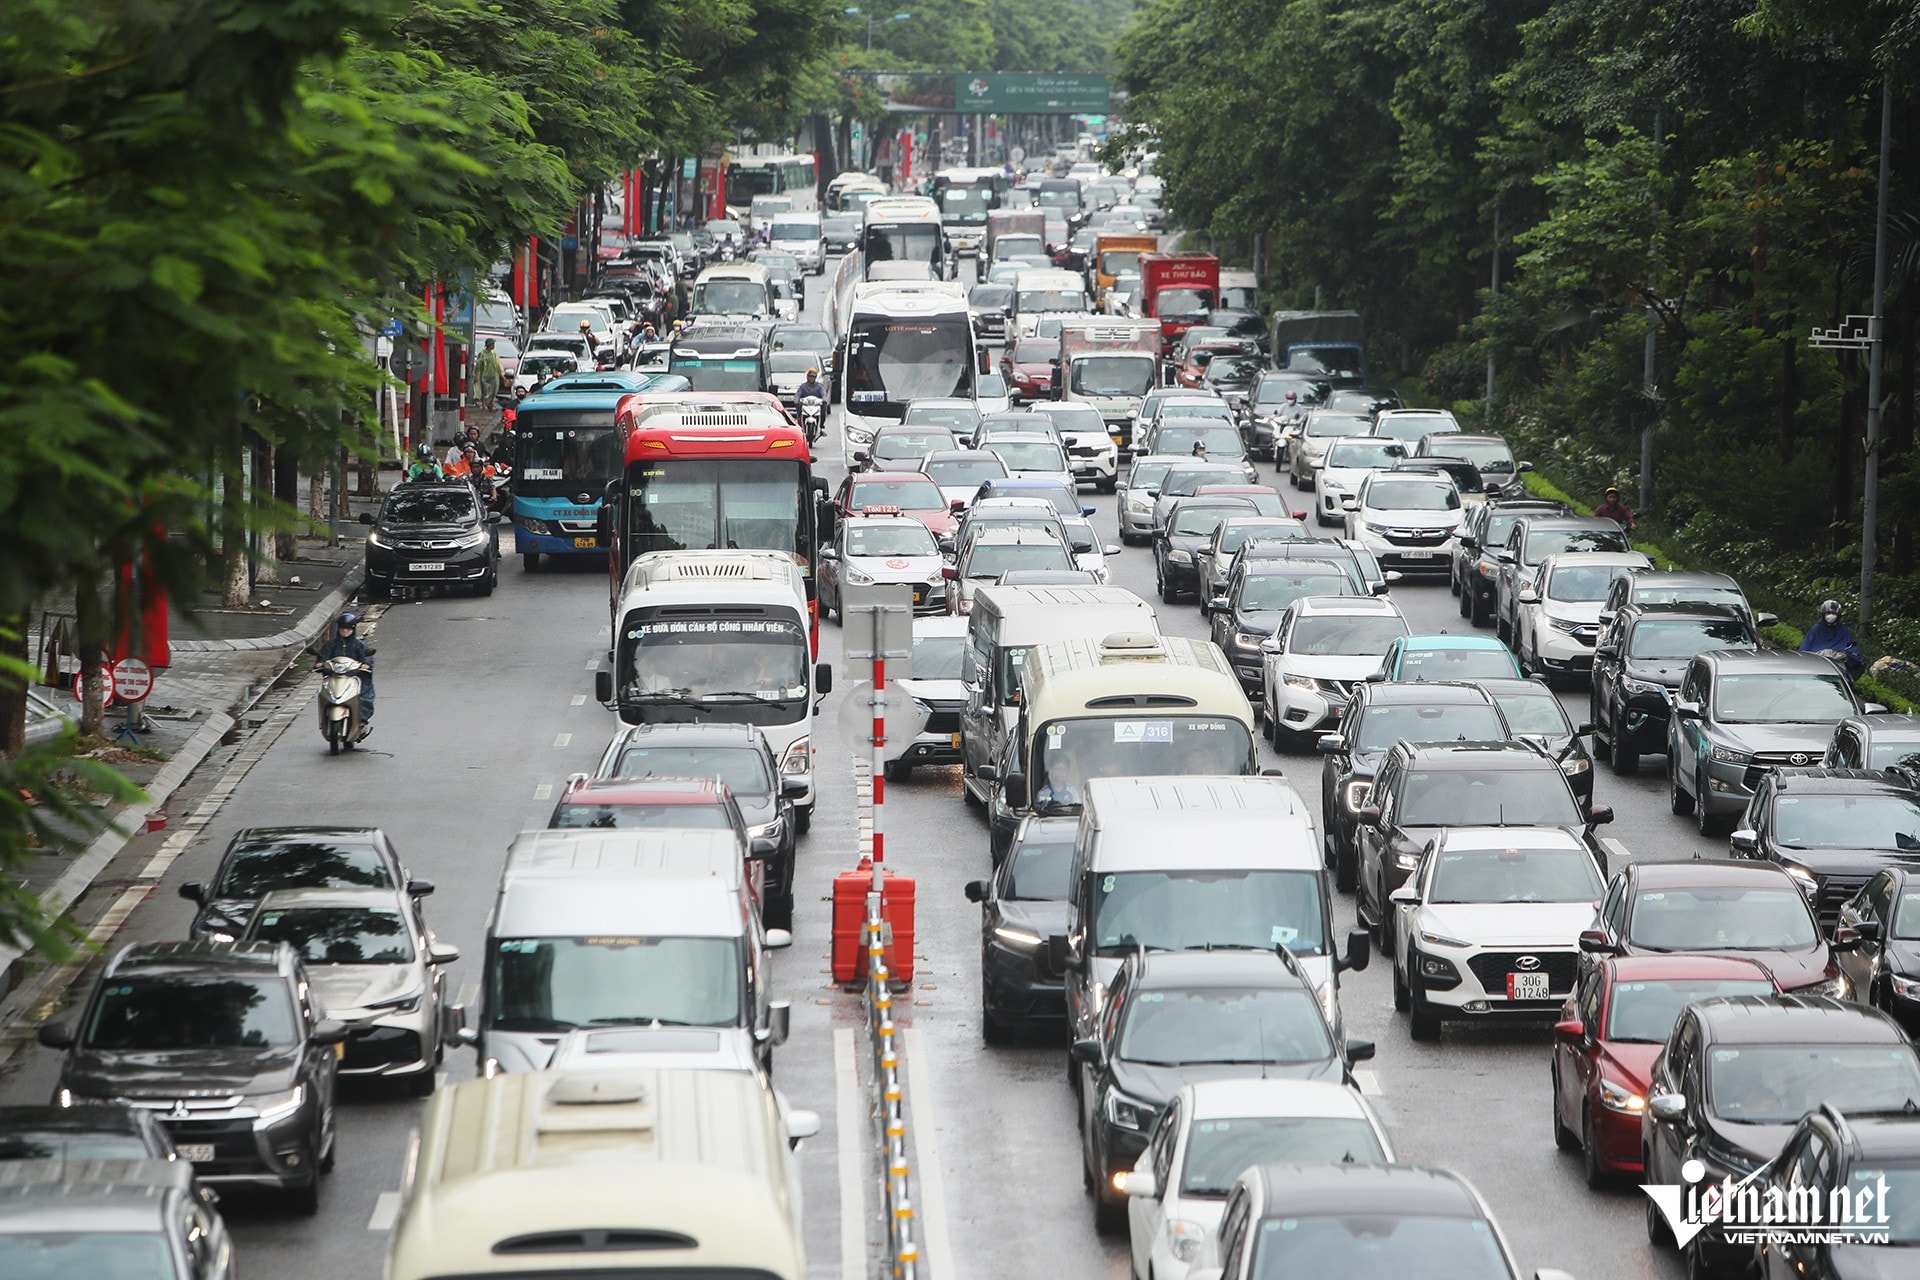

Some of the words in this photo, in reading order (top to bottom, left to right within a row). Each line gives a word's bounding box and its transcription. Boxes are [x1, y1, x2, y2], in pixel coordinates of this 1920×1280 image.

[641, 625, 651, 634] XE
[671, 622, 687, 633] ĐÓN
[707, 621, 717, 633] BỘ
[719, 622, 740, 632] CÔNG
[743, 622, 765, 632] NHÂN
[766, 622, 784, 633] VIÊN
[1148, 727, 1168, 736] 316
[1522, 976, 1540, 986] 30G
[1515, 988, 1548, 998] 012.48
